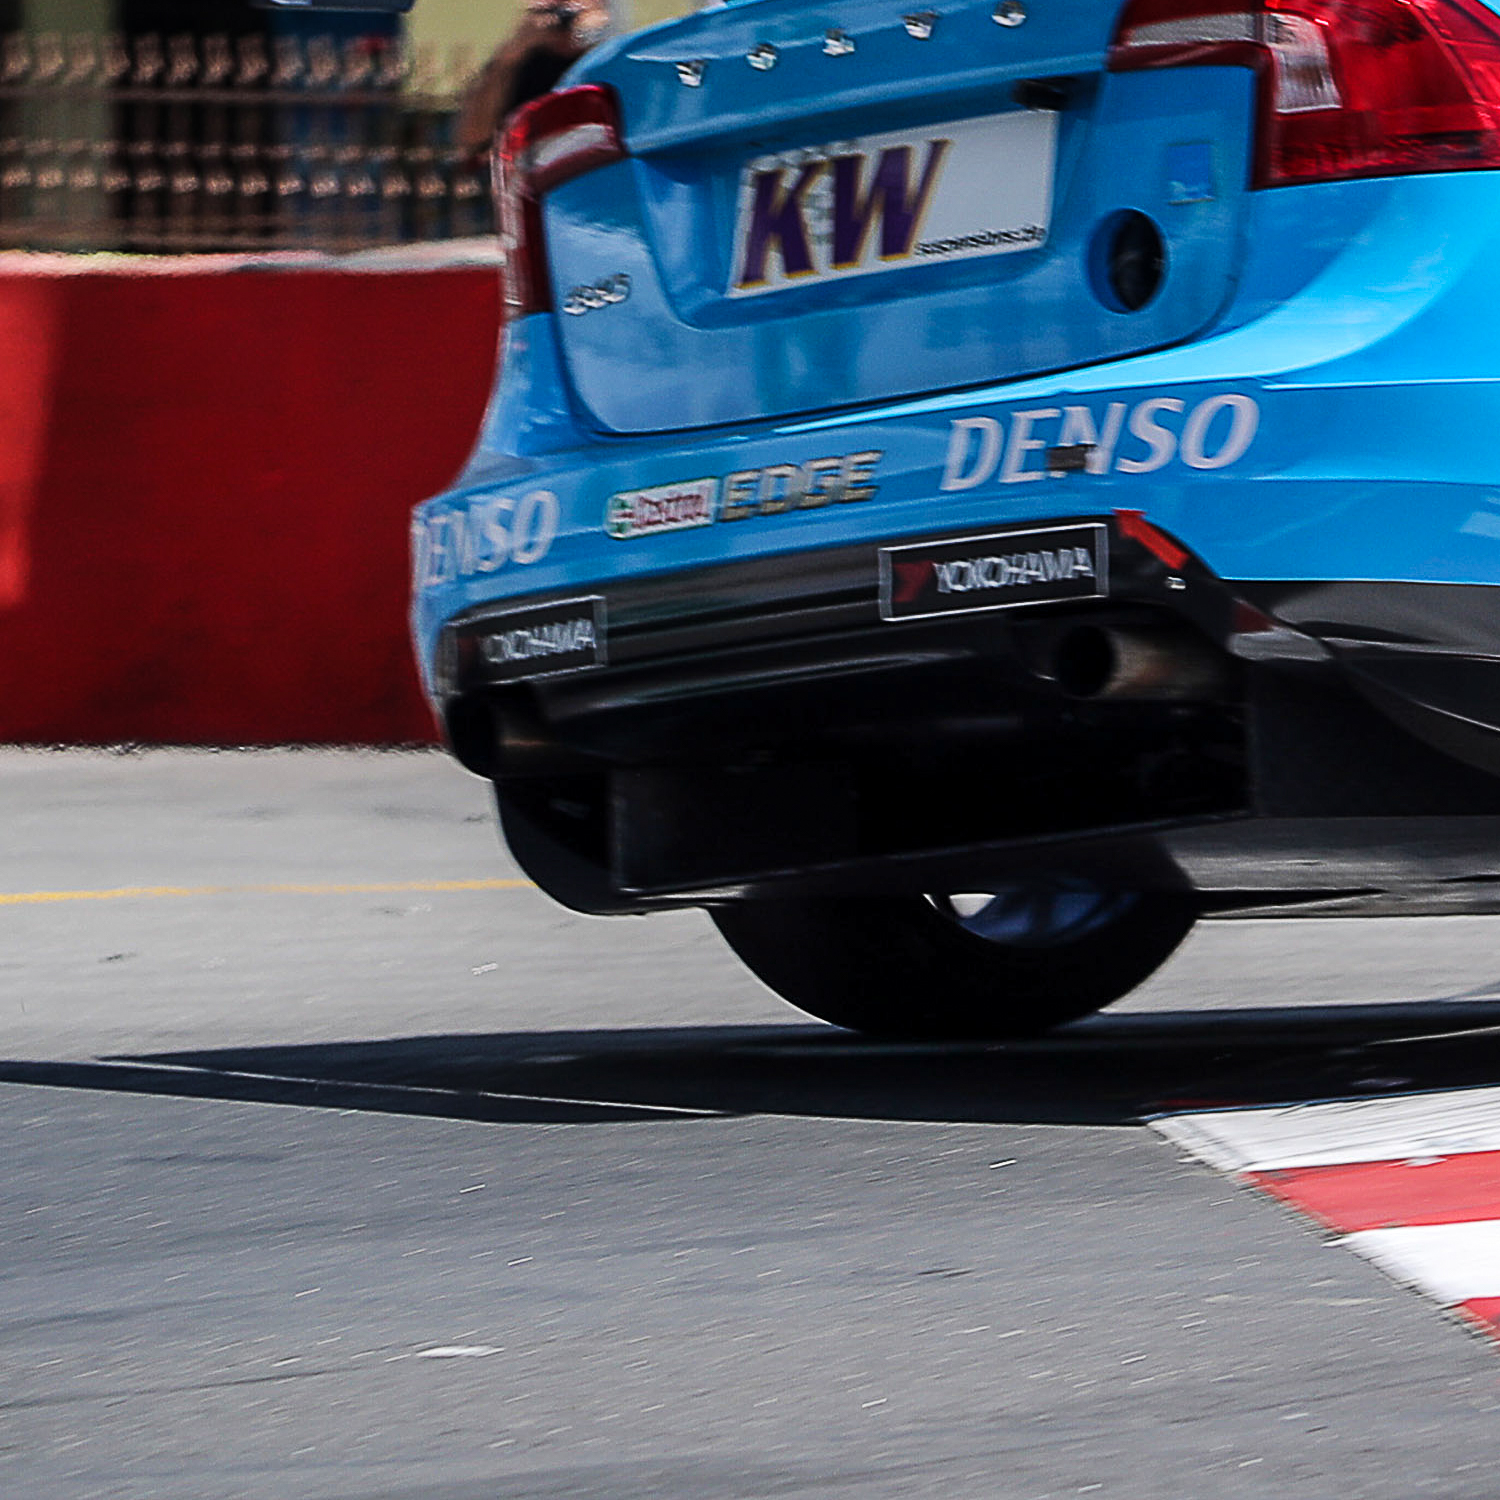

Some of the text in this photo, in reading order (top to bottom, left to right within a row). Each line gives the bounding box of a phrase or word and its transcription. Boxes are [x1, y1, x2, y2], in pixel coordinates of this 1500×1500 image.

[733, 137, 953, 290] KW
[939, 393, 1260, 492] DENSO
[718, 449, 884, 524] EDGE
[933, 546, 1096, 594] YOKOHAMA
[481, 617, 597, 664] OKOHAMA
